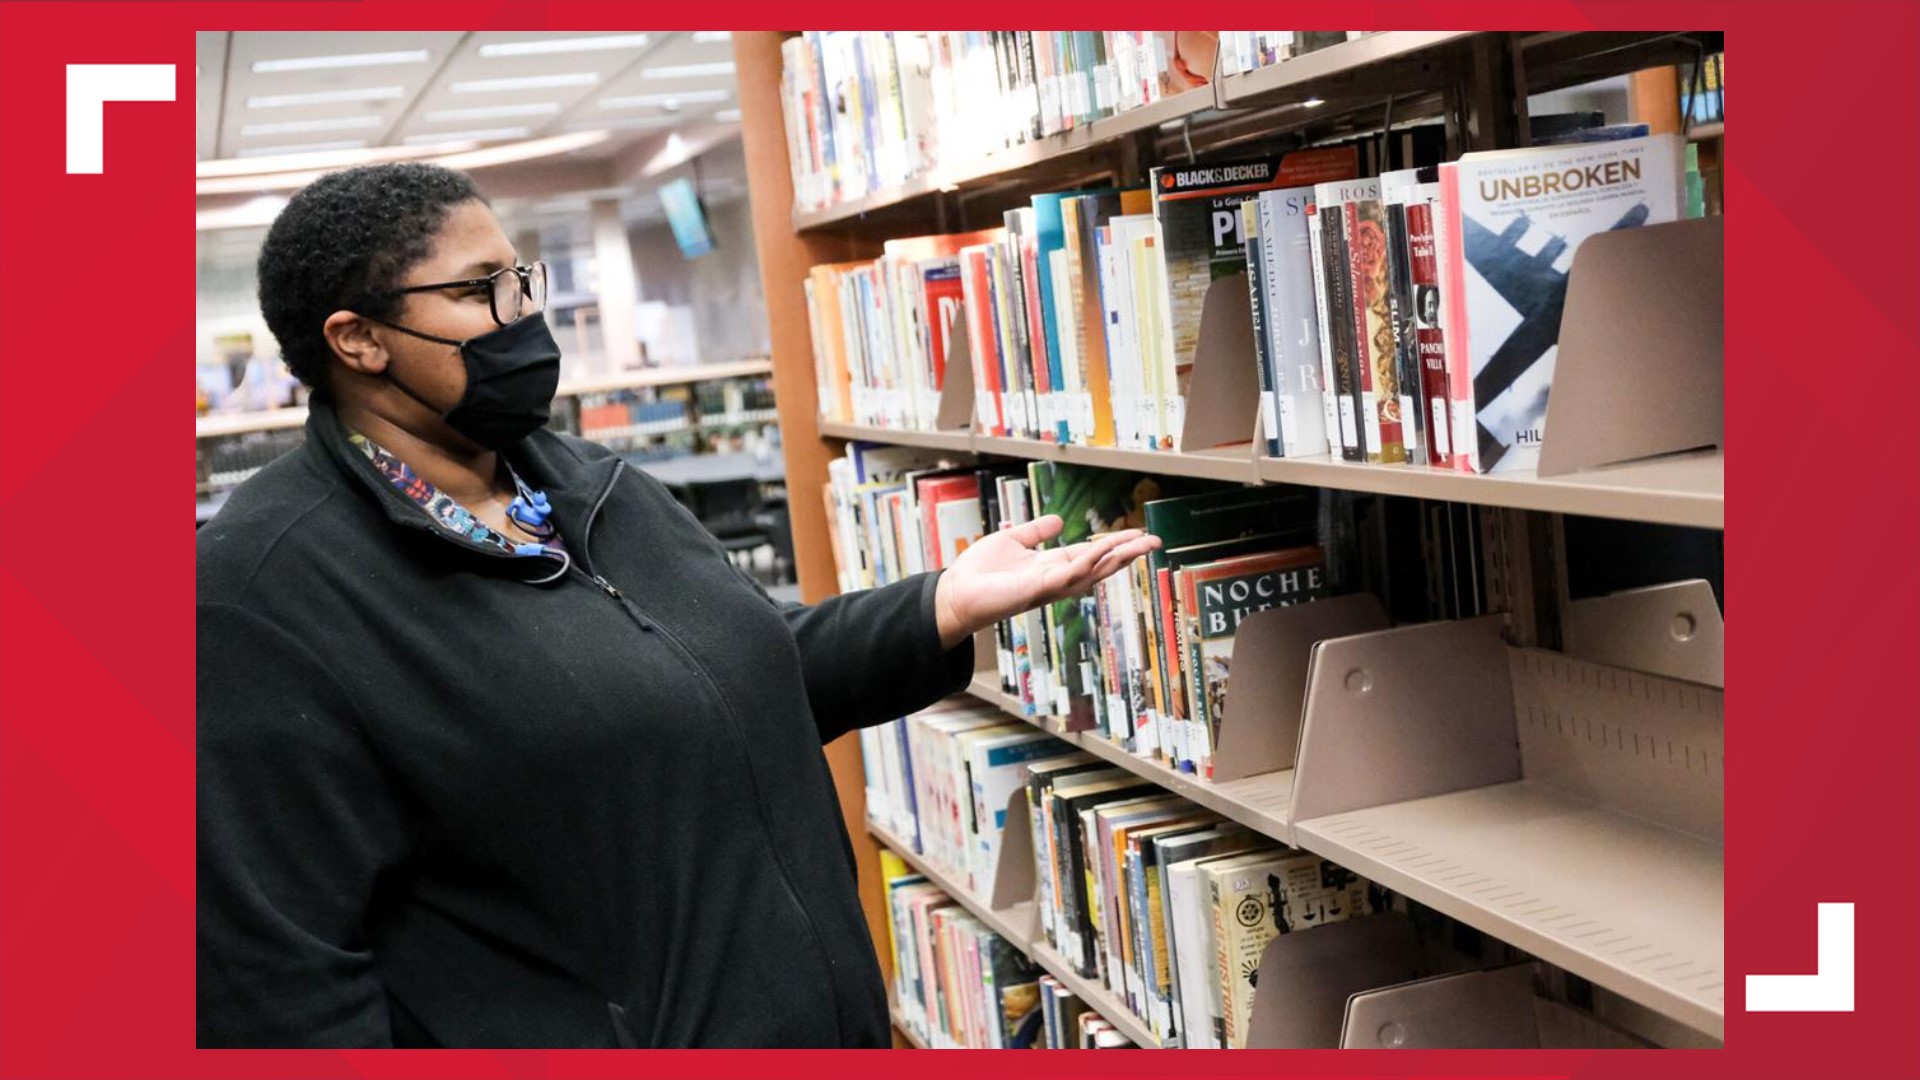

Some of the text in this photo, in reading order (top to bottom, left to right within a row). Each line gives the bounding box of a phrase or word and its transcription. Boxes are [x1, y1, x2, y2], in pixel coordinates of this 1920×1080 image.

[1176, 164, 1269, 187] BLACK&DECKER
[1480, 158, 1641, 202] UNBROKEN
[1390, 297, 1401, 344] SLIM
[1203, 566, 1323, 607] NOCHE
